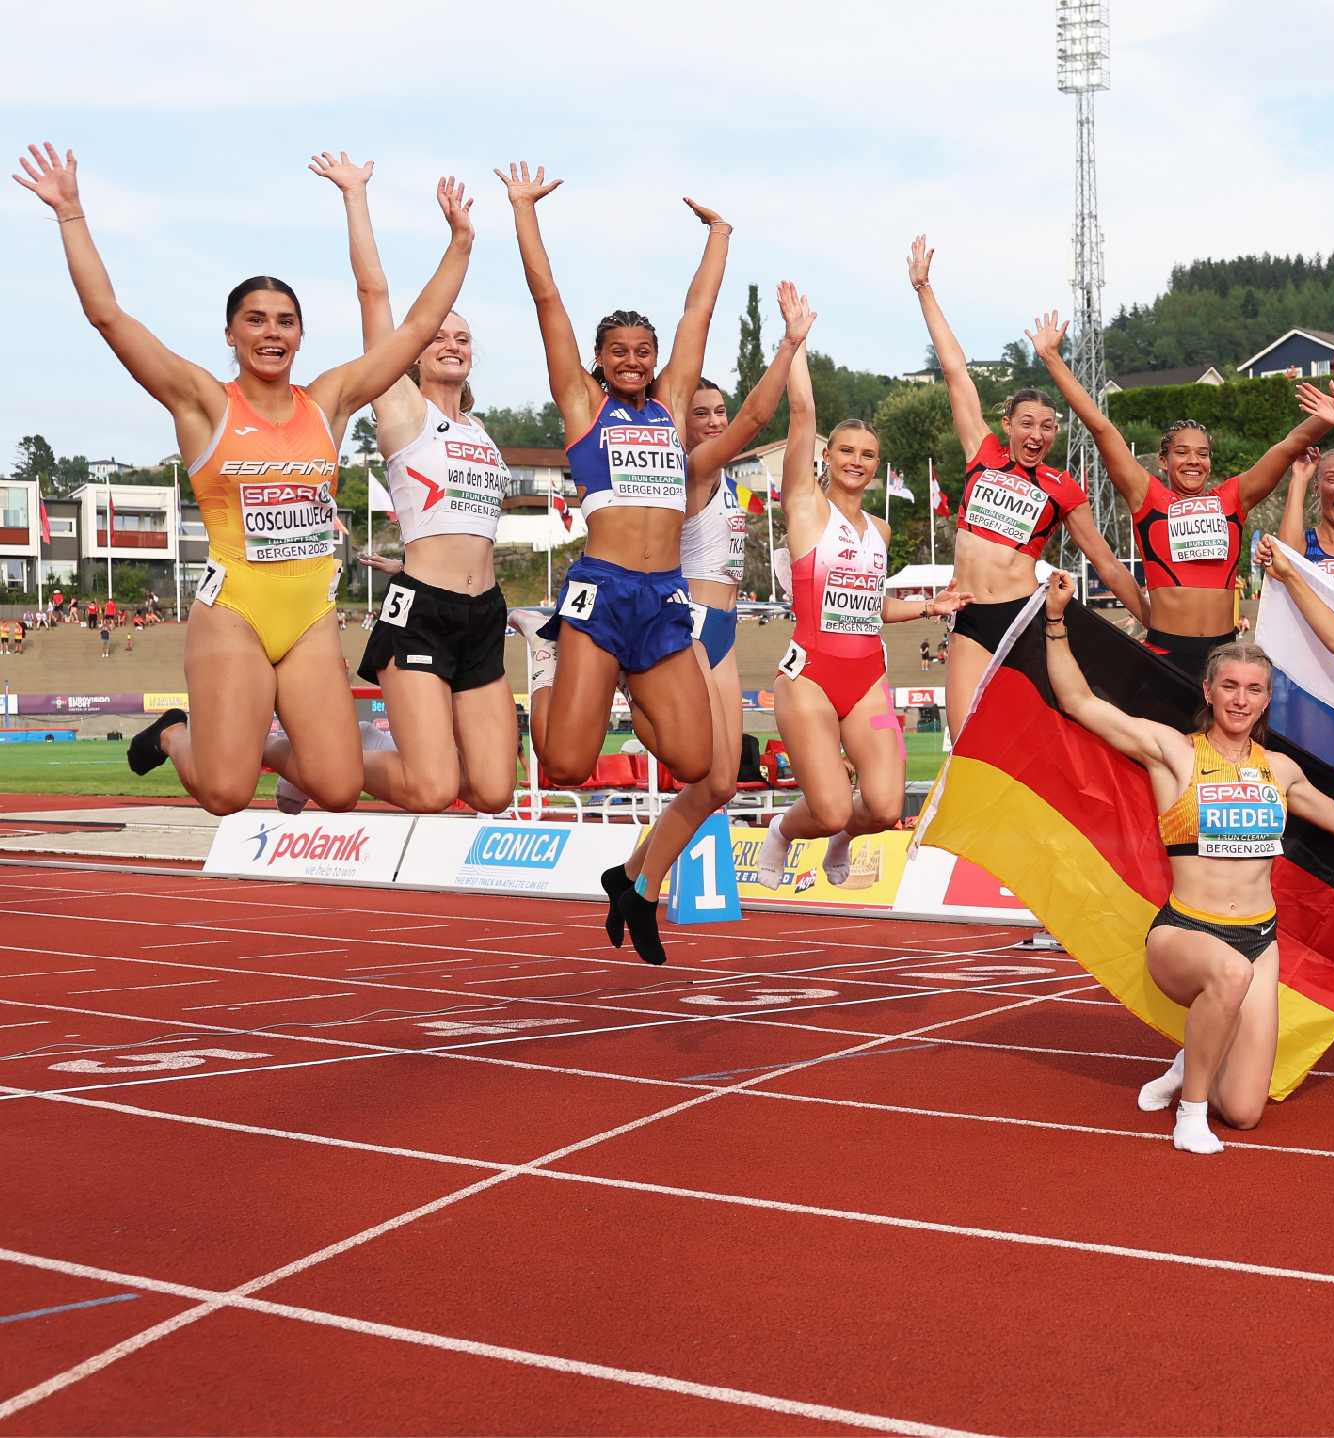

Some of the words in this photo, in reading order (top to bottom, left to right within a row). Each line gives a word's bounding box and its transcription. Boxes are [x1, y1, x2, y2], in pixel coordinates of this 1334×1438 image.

[610, 429, 668, 444] SPAR
[447, 443, 498, 464] SPAR
[611, 450, 683, 471] BASTIEN
[219, 458, 337, 476] ESPAÑA
[448, 468, 464, 484] van
[466, 467, 482, 488] den
[982, 471, 1031, 495] SPAR
[244, 487, 315, 504] SPAR
[619, 484, 661, 495] BERGEN
[662, 486, 683, 497] 2025
[450, 500, 489, 516] BERGEN
[974, 484, 1039, 520] TRÜMPI
[1171, 500, 1219, 516] SPAR
[245, 507, 333, 532] COSCULLUELA
[968, 512, 1001, 530] BERGEN
[1002, 526, 1025, 540] 2025
[256, 545, 307, 560] BERGEN
[308, 543, 329, 555] 2025
[838, 548, 858, 560] 4F
[1177, 548, 1215, 560] BERGEN
[199, 565, 217, 592] 7
[829, 574, 877, 590] SPAR
[388, 591, 404, 618] 5
[571, 589, 588, 613] 4
[824, 590, 882, 612] NOWICKA
[825, 621, 863, 632] BERGEN
[1201, 786, 1260, 800] SPAR
[1206, 808, 1279, 828] RIEDEL
[267, 825, 370, 866] polanik
[482, 832, 561, 862] CONICA
[1206, 844, 1252, 853] BERGEN
[1254, 843, 1275, 853] 2025
[305, 866, 316, 876] we
[317, 864, 332, 878] help
[333, 867, 341, 877] to
[341, 866, 357, 878] win
[689, 835, 727, 910] 1
[454, 877, 464, 885] THE
[479, 878, 494, 886] TRACK
[502, 880, 525, 889] ATHLETE
[525, 881, 536, 889] CAN
[537, 881, 549, 890] GET
